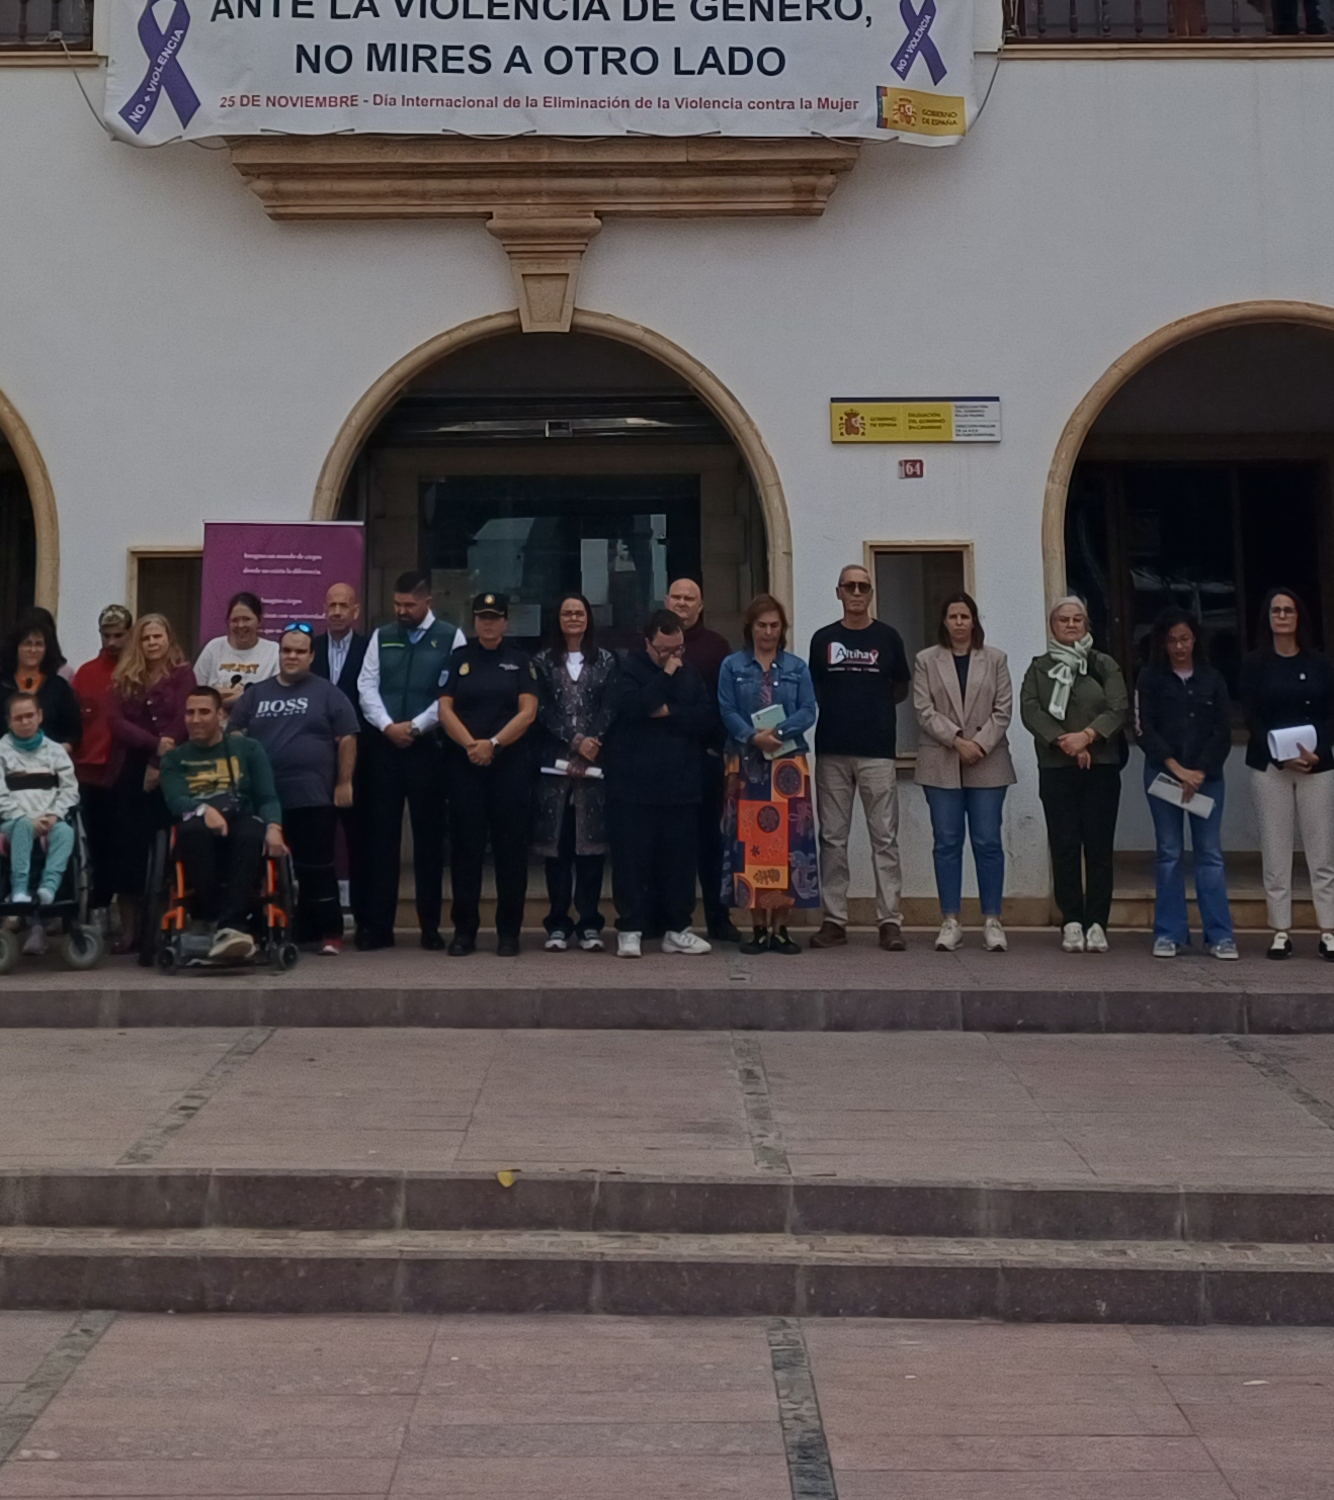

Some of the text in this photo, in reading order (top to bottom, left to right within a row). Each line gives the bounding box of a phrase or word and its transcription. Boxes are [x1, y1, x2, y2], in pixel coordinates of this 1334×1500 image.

[896, 58, 908, 73] NO
[906, 14, 932, 54] VIOLENCIA
[296, 43, 786, 77] NO MIRES A OTRO LADO
[128, 104, 147, 123] NO
[146, 28, 185, 93] VIOLENCIA
[219, 95, 236, 108] 25
[239, 94, 261, 108] DE
[266, 94, 359, 108] NOVIEMBRE
[372, 93, 397, 107] Día
[401, 94, 498, 109] Internacional
[503, 95, 521, 109] de
[525, 95, 538, 109] la
[543, 95, 630, 110] Eliminación
[634, 96, 653, 110] de
[657, 97, 670, 110] la
[674, 97, 743, 110] Violencia
[747, 98, 795, 111] contra
[800, 98, 813, 111] la
[817, 98, 859, 113] Mujer
[906, 462, 921, 476] 64
[257, 697, 309, 714] BOSS
